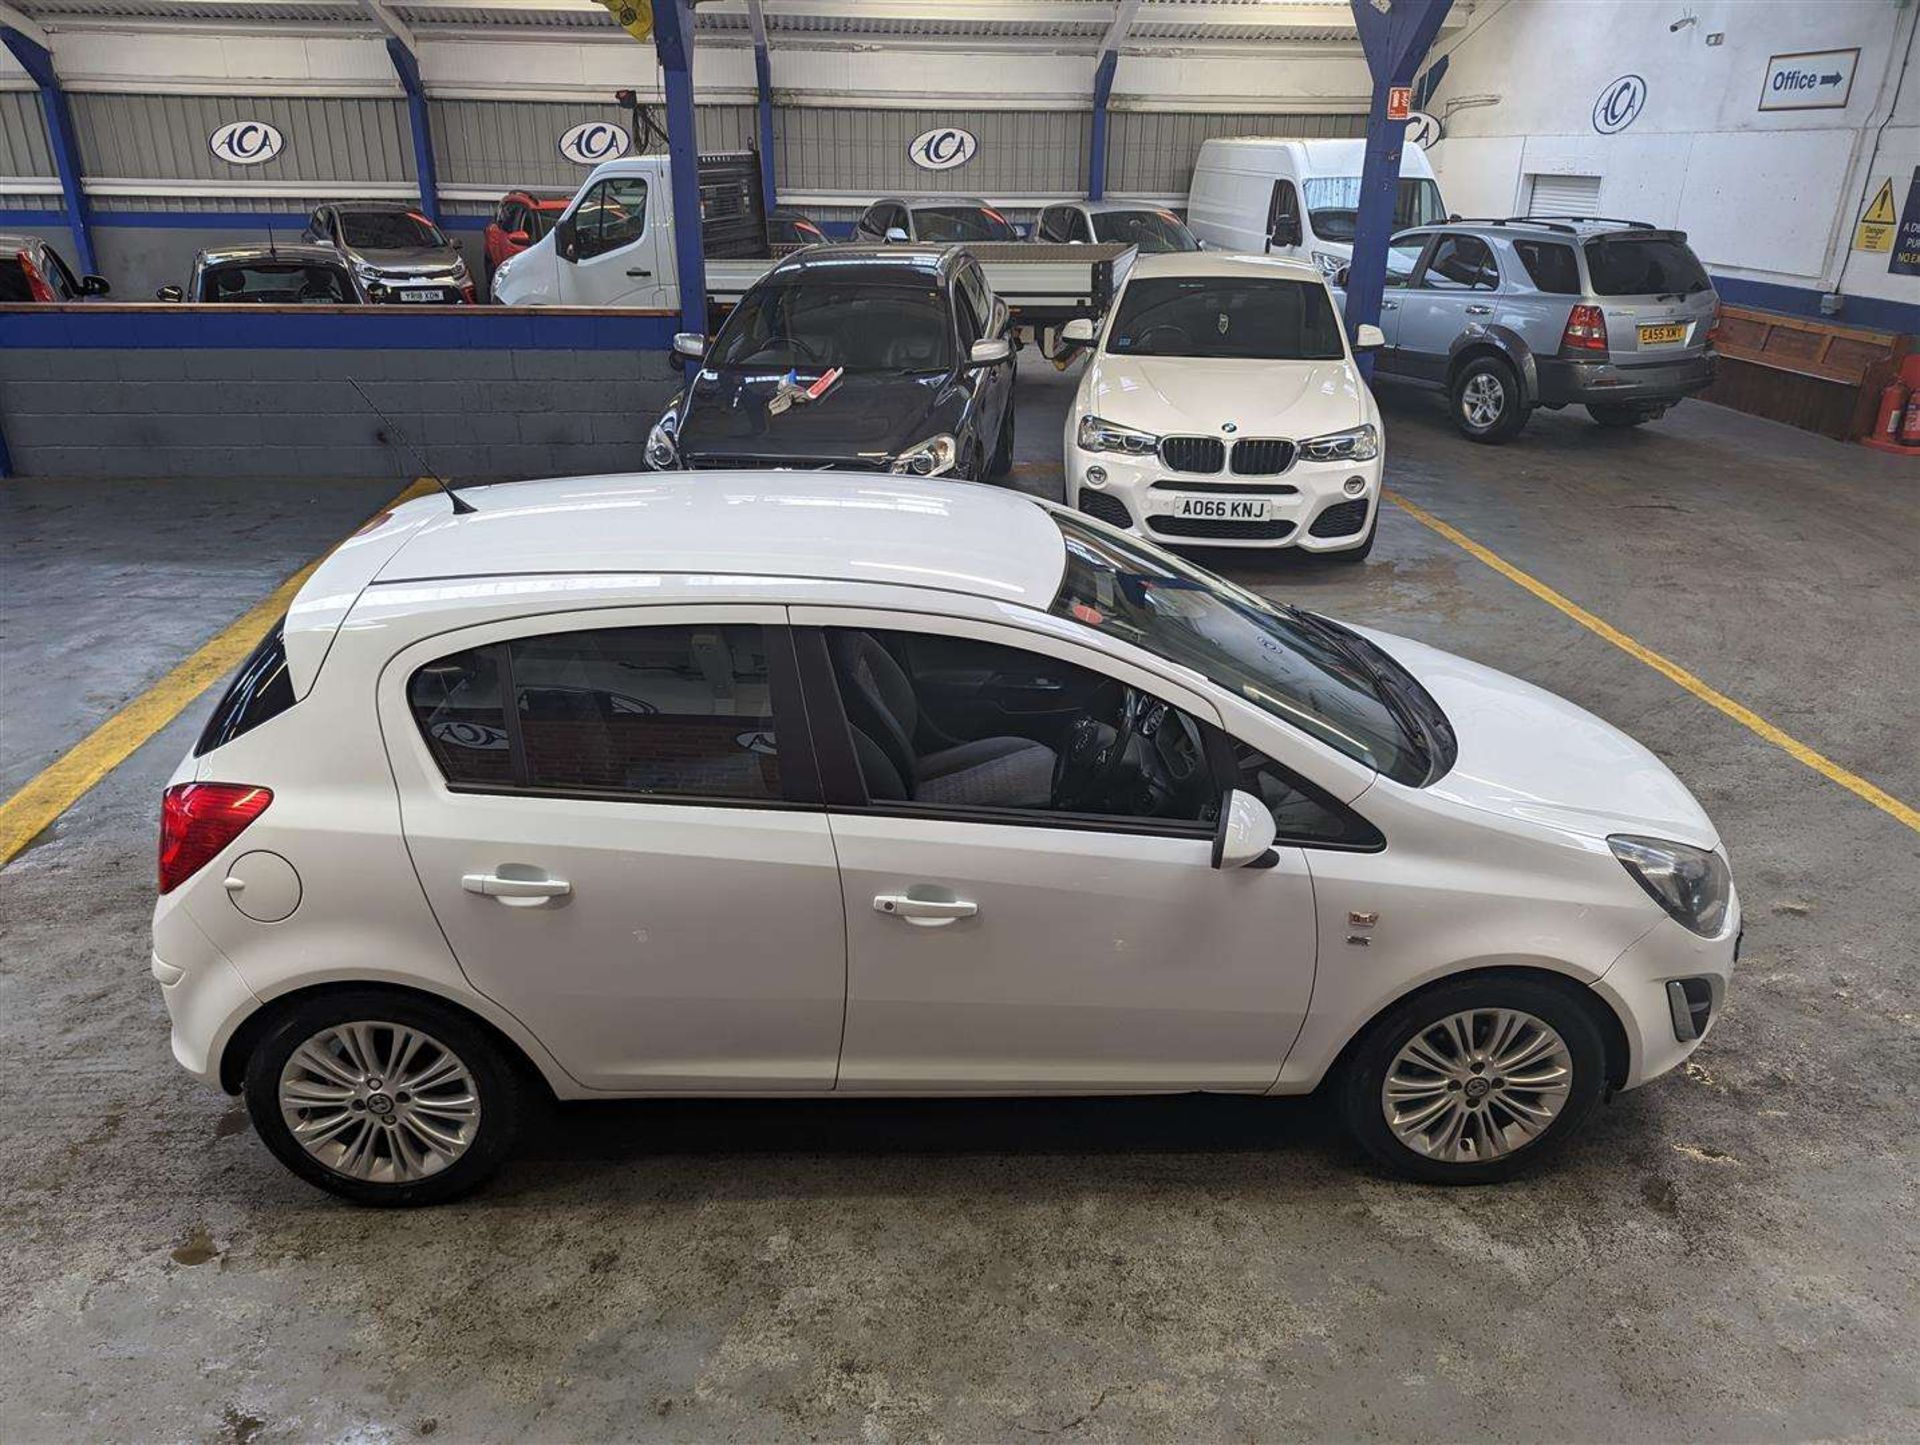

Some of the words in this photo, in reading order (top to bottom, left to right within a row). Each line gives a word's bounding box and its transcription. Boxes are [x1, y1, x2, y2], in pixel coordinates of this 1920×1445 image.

[1773, 71, 1817, 91] Office
[1595, 81, 1637, 127] ACA
[215, 125, 275, 158] ACA
[564, 126, 621, 159] ACA
[912, 131, 967, 164] ACA
[1642, 328, 1665, 341] EA55
[1182, 500, 1226, 516] AO66
[1230, 502, 1265, 518] KNJ
